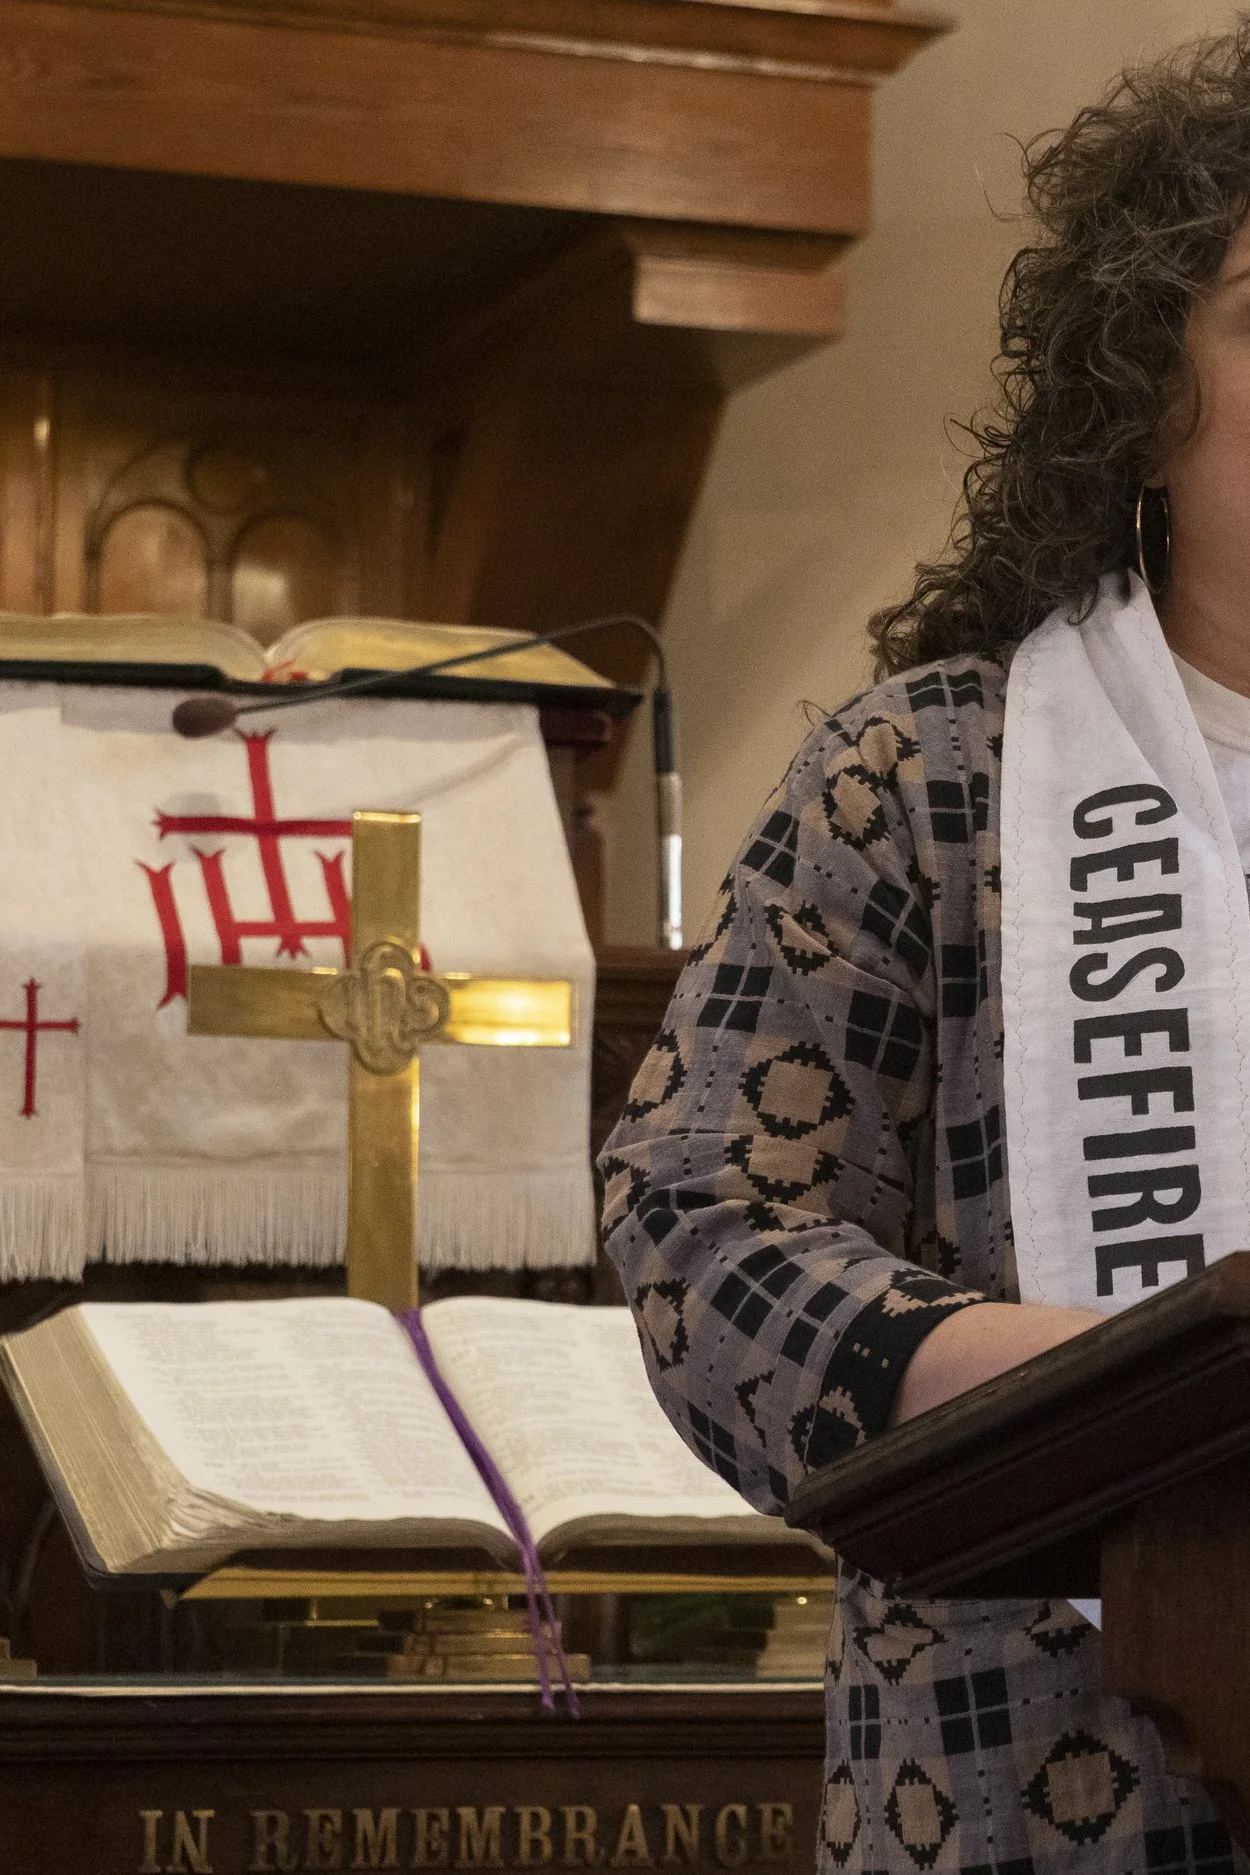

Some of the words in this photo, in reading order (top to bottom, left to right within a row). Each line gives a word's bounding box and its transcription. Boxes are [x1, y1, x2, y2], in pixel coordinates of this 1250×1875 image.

[1069, 783, 1206, 1298] CEASEFIRE
[138, 1808, 216, 1874] IN
[248, 1802, 794, 1872] REMEMBRANCE
